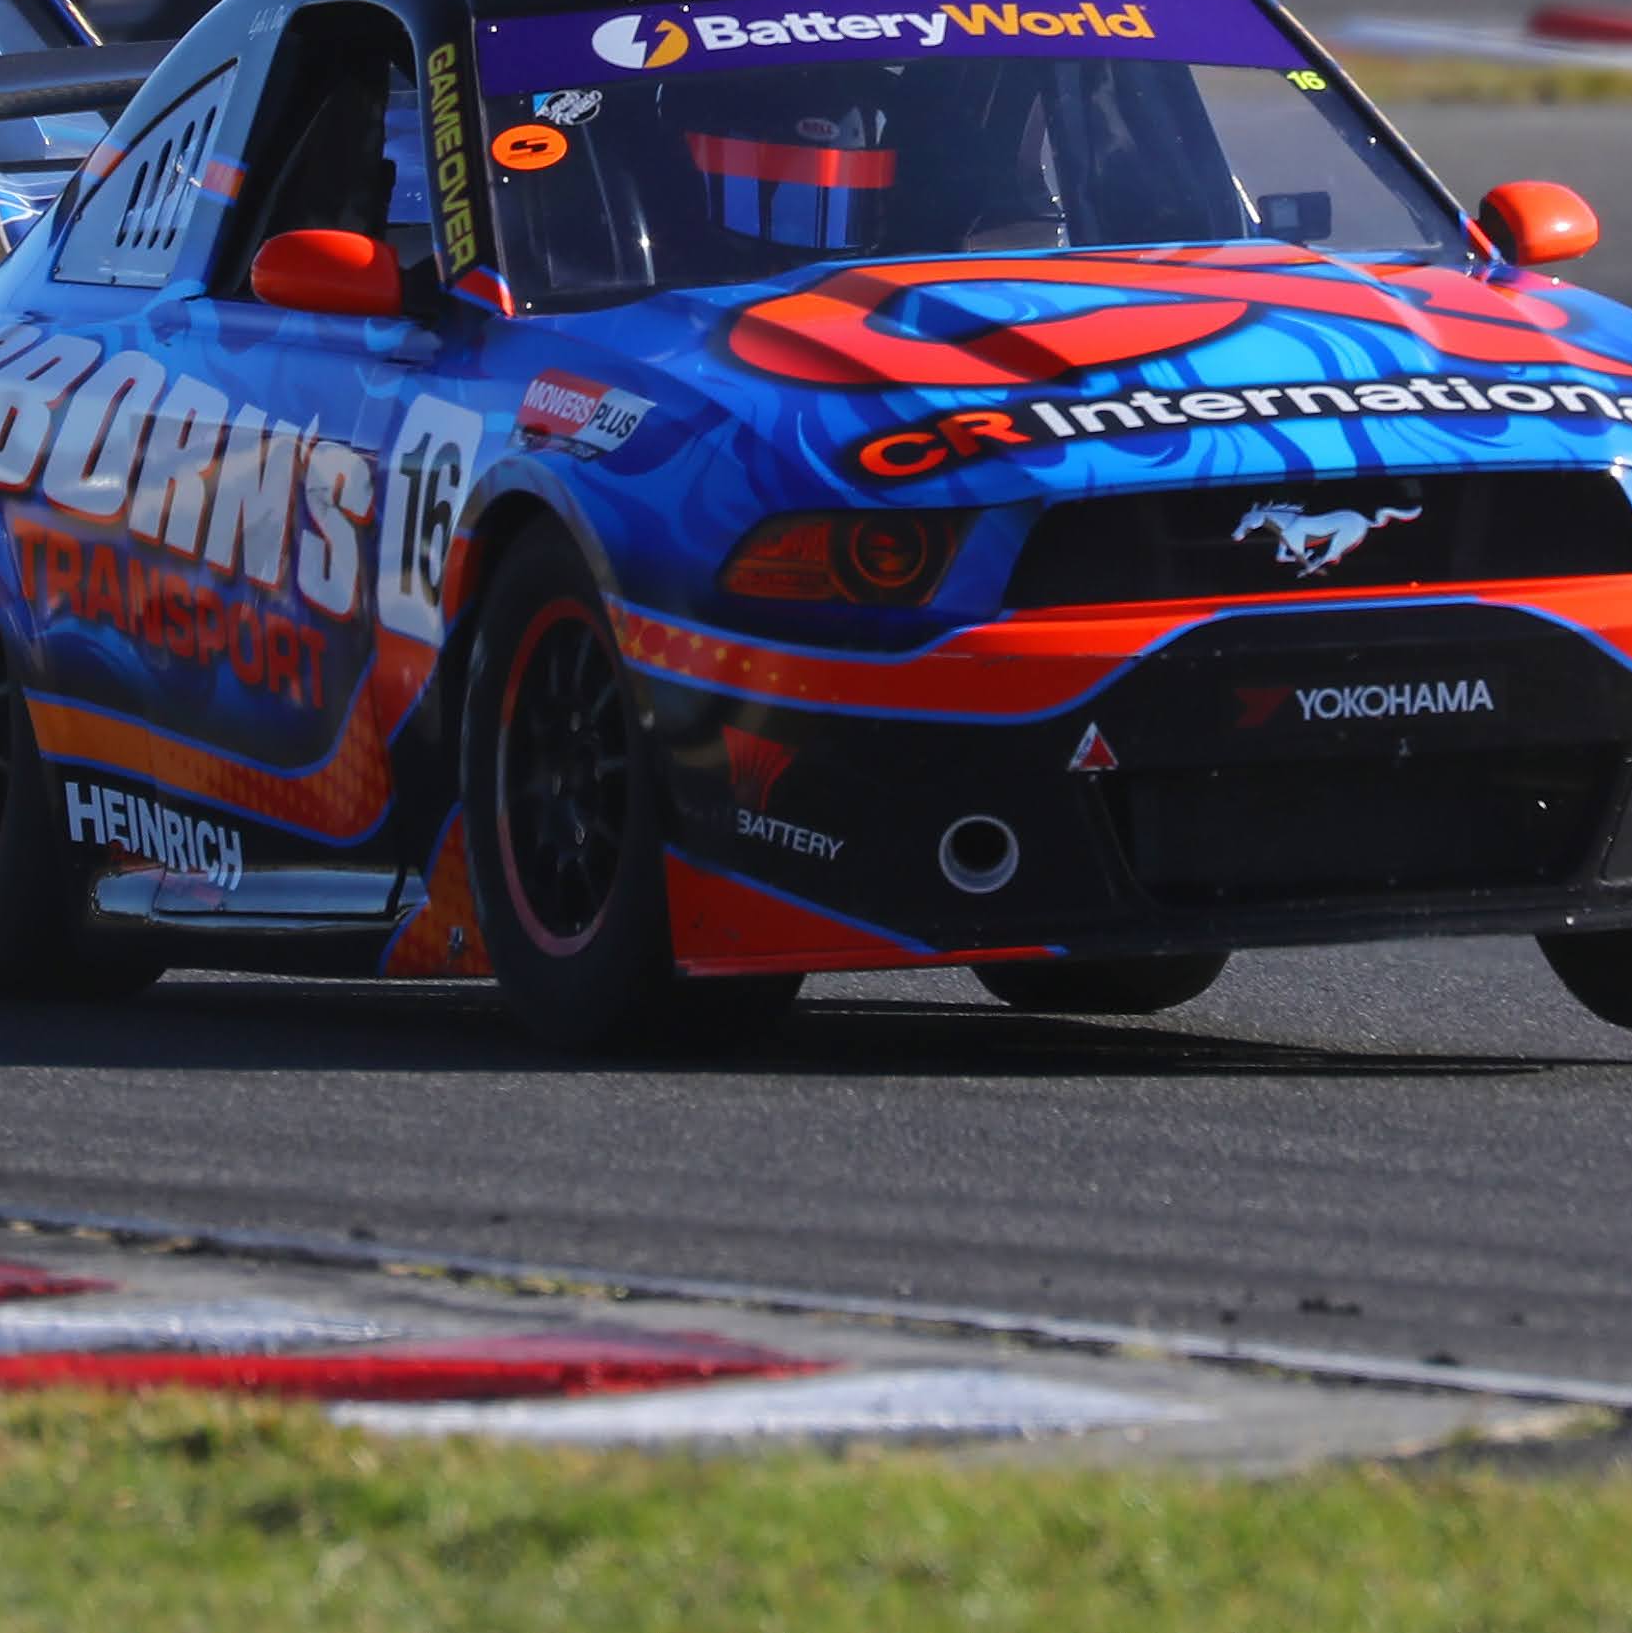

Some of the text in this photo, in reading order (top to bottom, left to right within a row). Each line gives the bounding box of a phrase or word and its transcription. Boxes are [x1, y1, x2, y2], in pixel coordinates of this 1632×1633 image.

[1286, 70, 1327, 90] 16
[523, 378, 638, 440] MOWERS PLUS
[856, 409, 1031, 478] CR
[398, 430, 462, 608] 16
[12, 516, 327, 709] TRANSPORT
[1295, 679, 1495, 721] YOKOHAMA
[64, 780, 244, 893] HEINRICH
[736, 806, 846, 862] BATTERY
